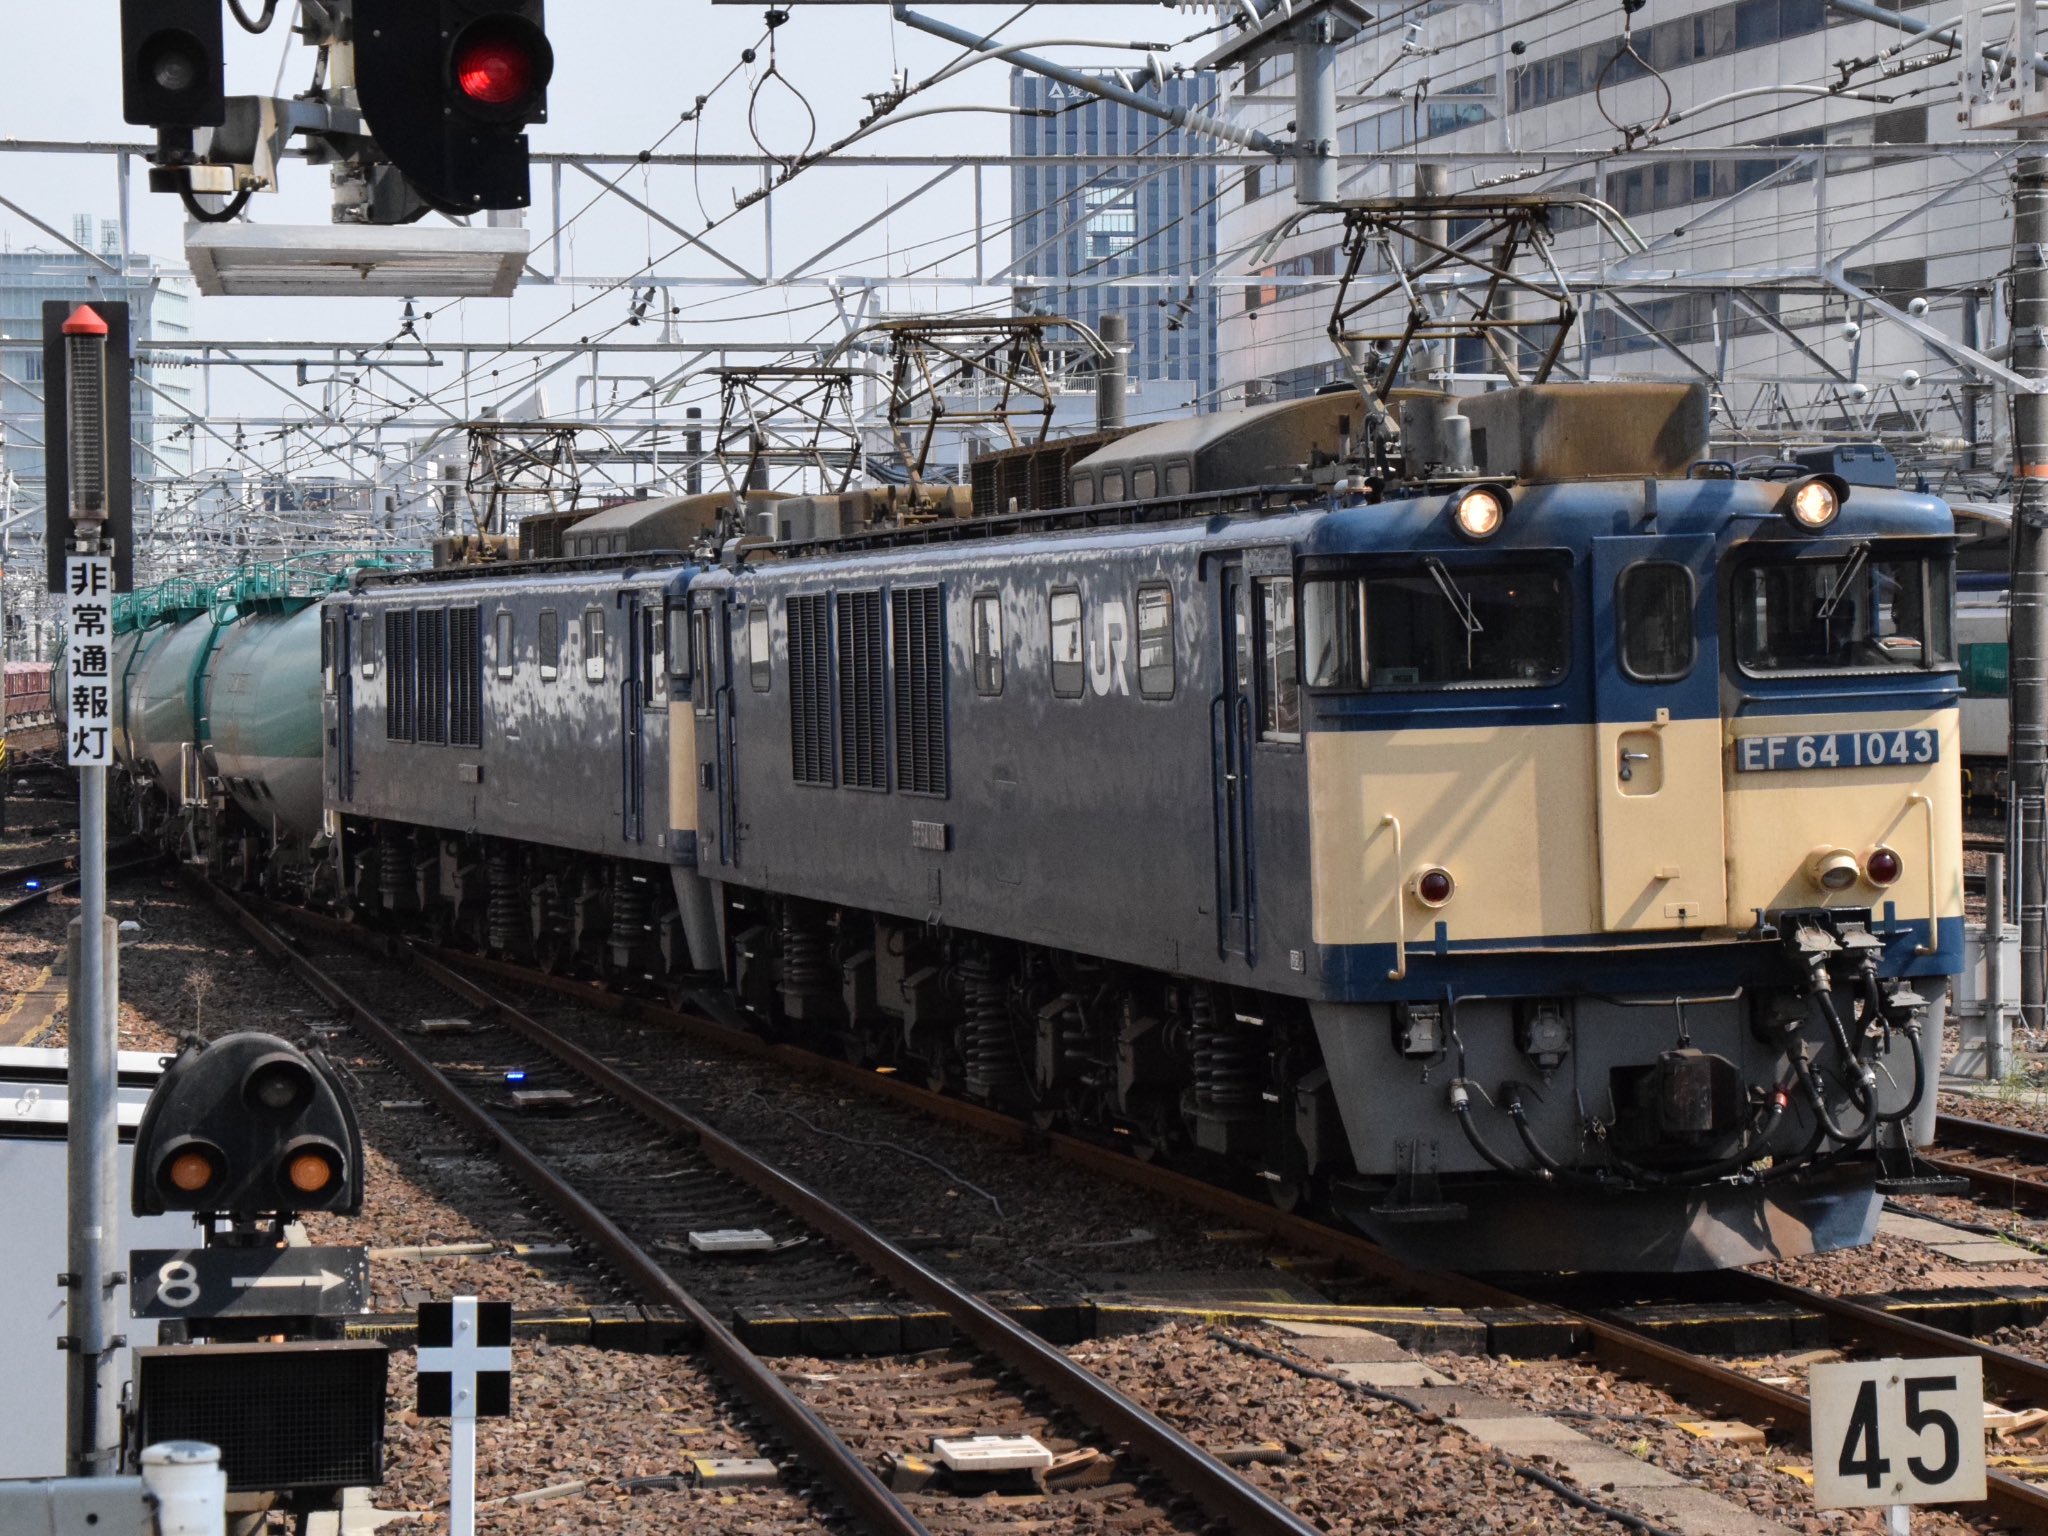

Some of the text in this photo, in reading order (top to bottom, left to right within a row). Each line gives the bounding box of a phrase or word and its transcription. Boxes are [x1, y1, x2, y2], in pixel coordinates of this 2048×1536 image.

[71, 562, 108, 760] 非常通報灯
[1090, 601, 1130, 696] JR
[1743, 730, 1933, 771] EF 64 1043
[157, 1260, 201, 1308] 8
[1838, 1375, 1960, 1489] 45
